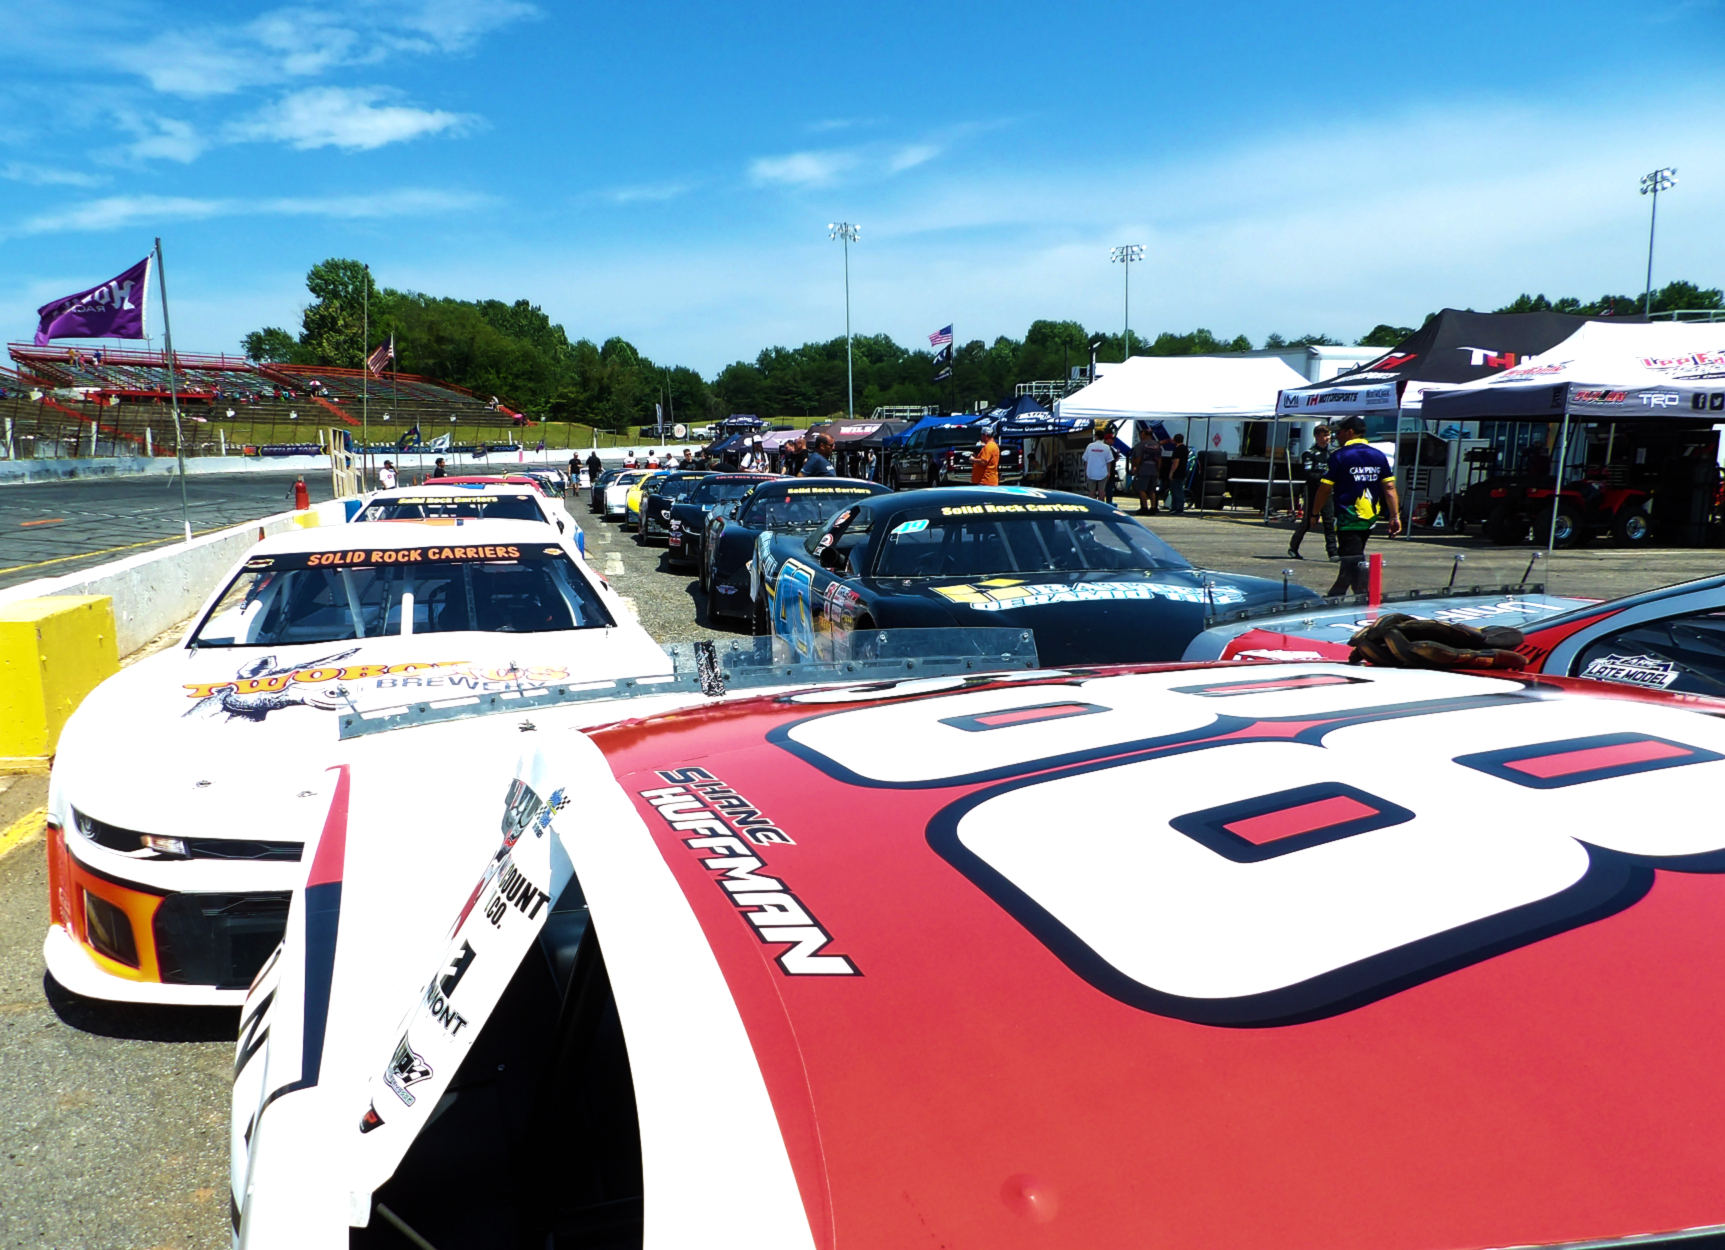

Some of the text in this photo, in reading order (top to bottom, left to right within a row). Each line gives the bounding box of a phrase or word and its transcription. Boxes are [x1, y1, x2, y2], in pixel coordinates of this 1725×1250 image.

[1638, 393, 1680, 408] TRD
[1349, 466, 1381, 475] CAMPING
[1353, 474, 1378, 482] WORLD
[941, 504, 1089, 515] Solid Rock Carriers
[307, 546, 520, 567] SOLID ROCK CARRIERS
[1586, 664, 1669, 685] LATE MODEL
[376, 676, 547, 692] BREWERY
[654, 766, 797, 846] SHANE
[637, 785, 865, 977] HUFFMAN
